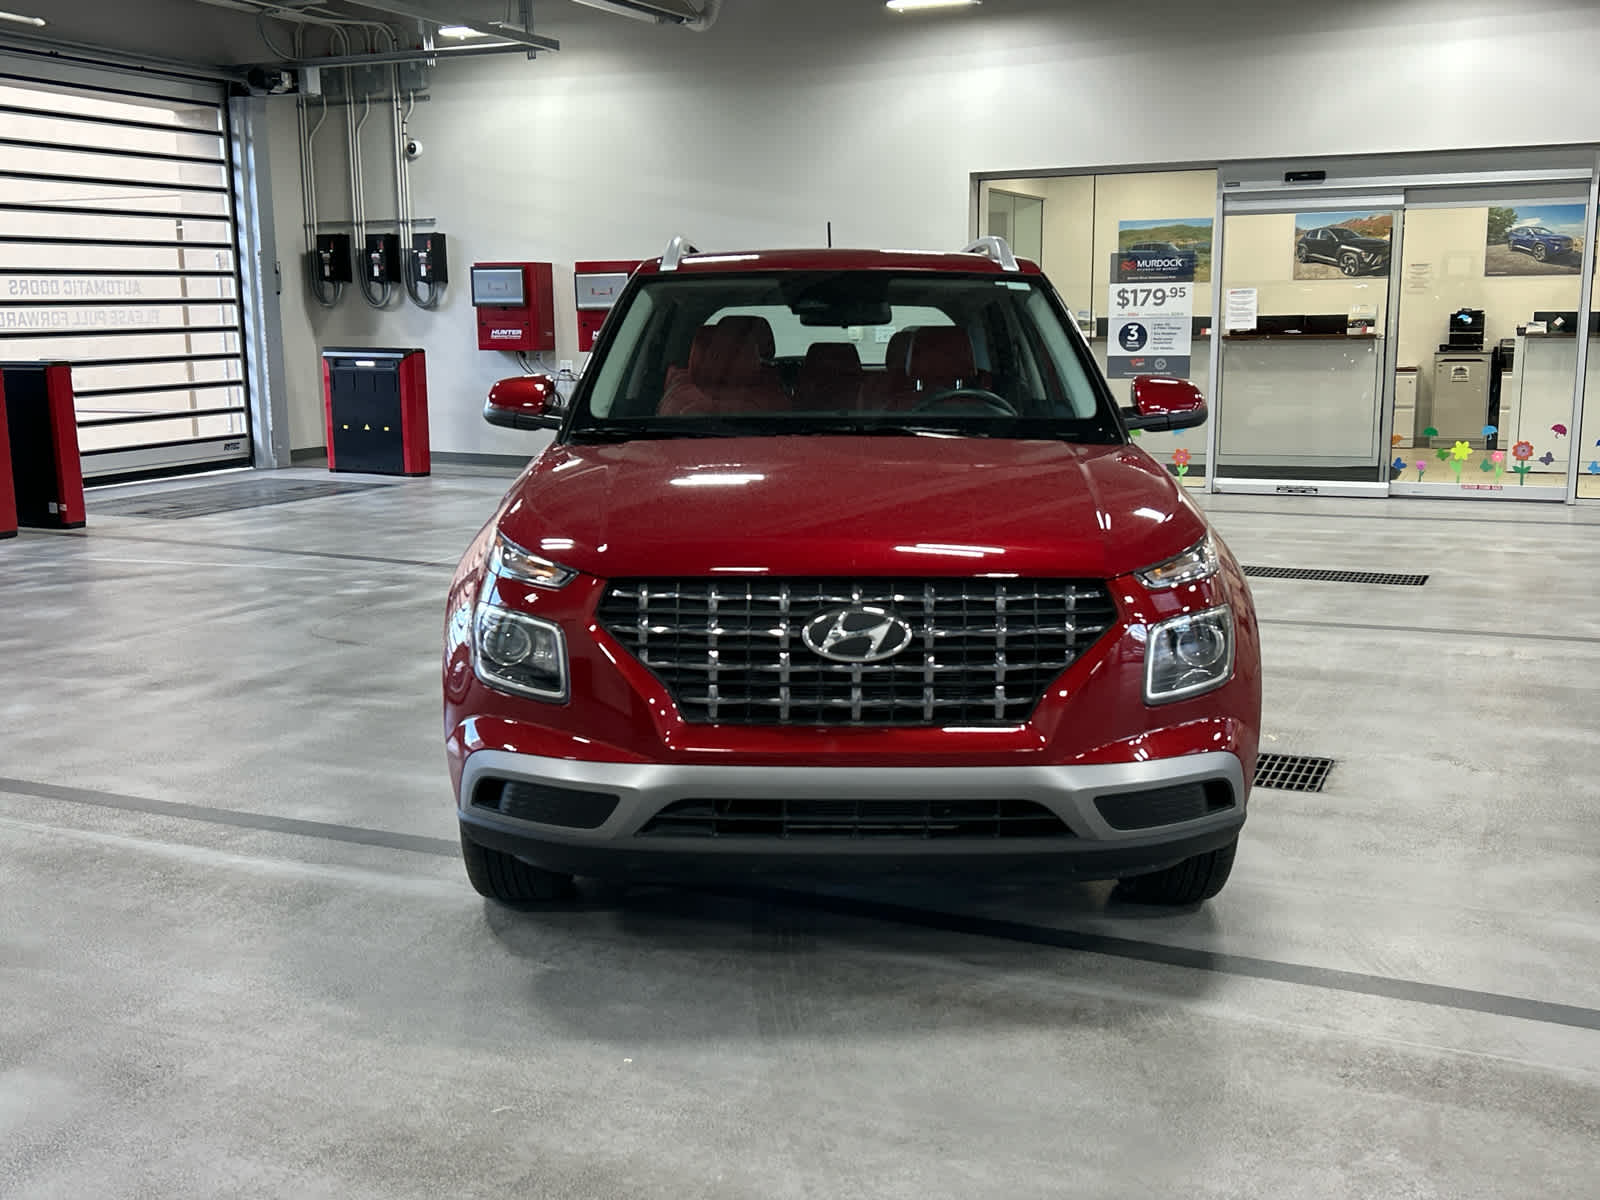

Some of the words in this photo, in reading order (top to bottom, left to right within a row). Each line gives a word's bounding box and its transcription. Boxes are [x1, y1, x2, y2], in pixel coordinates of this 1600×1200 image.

[1136, 258, 1182, 267] MURDOCK
[491, 328, 522, 337] HUNTER
[1127, 325, 1138, 340] 3
